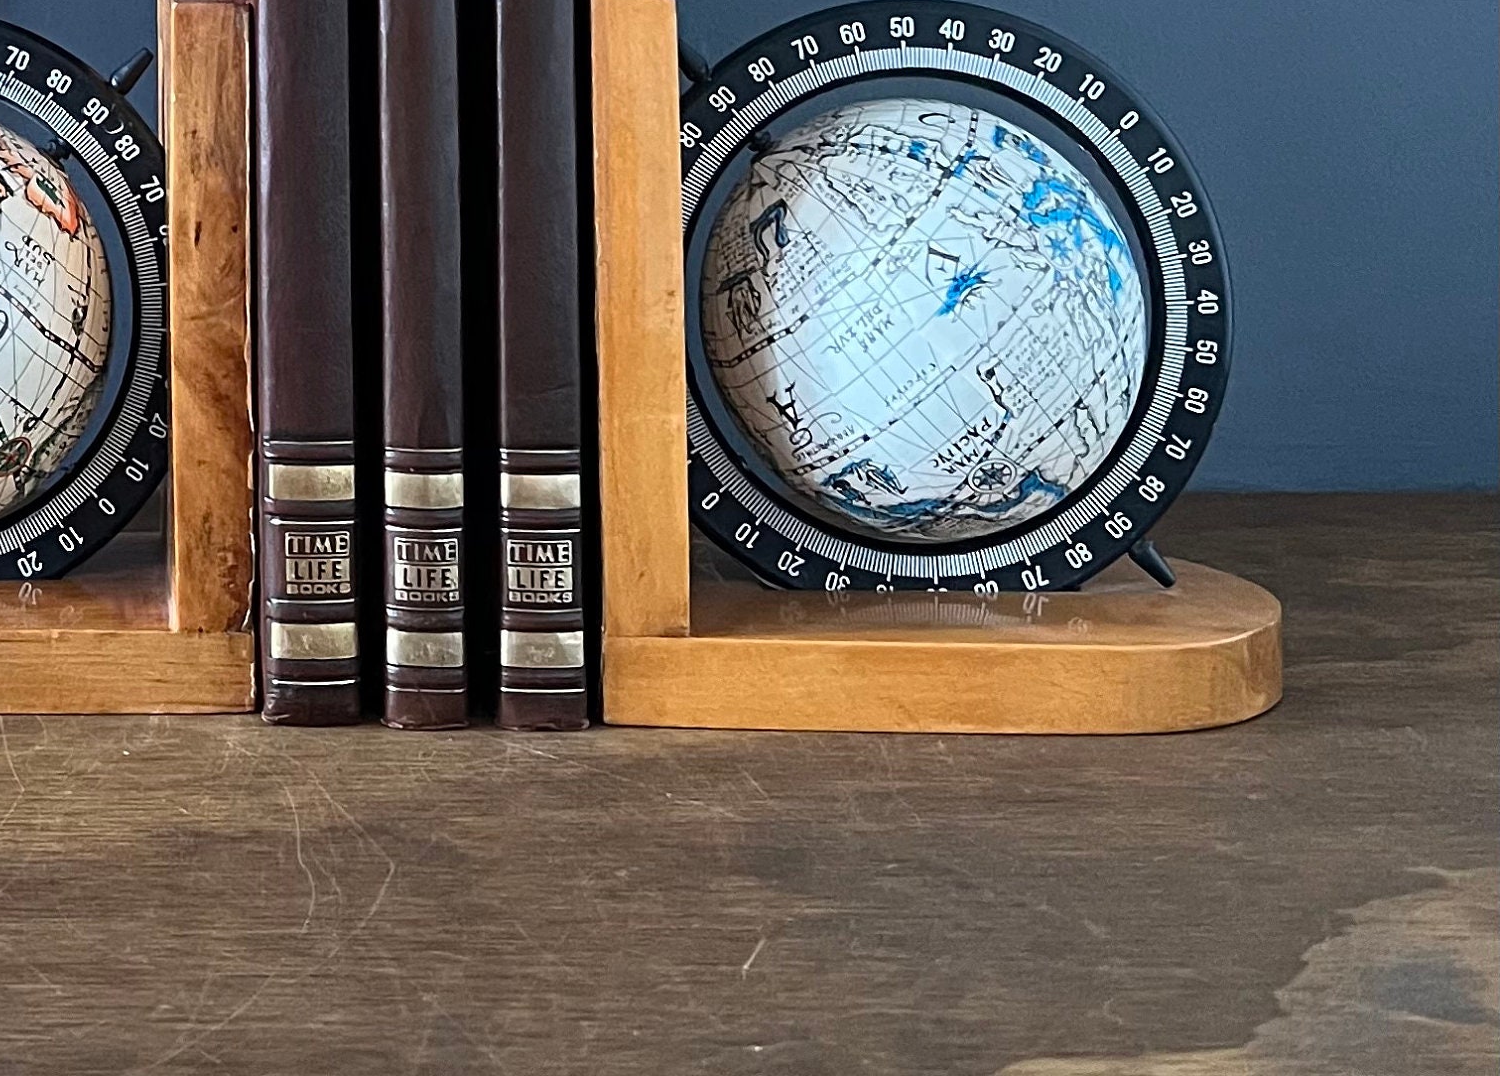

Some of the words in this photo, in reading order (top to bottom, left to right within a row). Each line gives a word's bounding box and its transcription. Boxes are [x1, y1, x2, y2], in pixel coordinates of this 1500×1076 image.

[840, 22, 865, 44] 60
[890, 17, 914, 37] 50
[939, 19, 964, 40] 40
[791, 36, 818, 59] 70
[989, 29, 1015, 52] 30
[6, 46, 29, 70] 70
[748, 58, 774, 81] 80
[1034, 47, 1061, 72] 20
[47, 69, 72, 93] 80
[1079, 74, 1105, 99] 10
[83, 98, 109, 124] 90
[709, 86, 735, 112] 90
[1120, 111, 1139, 129] 0
[680, 122, 702, 148] 80
[115, 135, 140, 160] 80
[1148, 148, 1174, 173] 10
[140, 176, 164, 202] 70
[1171, 192, 1197, 217] 20
[1189, 240, 1212, 264] 30
[1197, 290, 1218, 314] 40
[1196, 340, 1217, 364] 50
[1185, 388, 1208, 413] 60
[1166, 434, 1191, 459] 70
[126, 458, 148, 481] 10
[1139, 476, 1165, 501] 80
[99, 498, 115, 514] 0
[702, 493, 719, 509] 0
[735, 523, 759, 548] 10
[1105, 512, 1132, 538] 90
[59, 527, 83, 551] 10
[289, 535, 347, 553] TIME
[398, 542, 456, 560] TIME
[18, 551, 42, 577] 20
[511, 543, 569, 563] TIME
[778, 551, 805, 576] 20
[1065, 543, 1092, 568] 80
[293, 561, 342, 579] LIFE
[403, 567, 455, 587] LIFE
[517, 570, 566, 588] LIFE
[1022, 566, 1049, 590] 70
[286, 583, 351, 594] BOOKS
[396, 591, 459, 602] BOOKS
[509, 591, 572, 603] BOOKS
